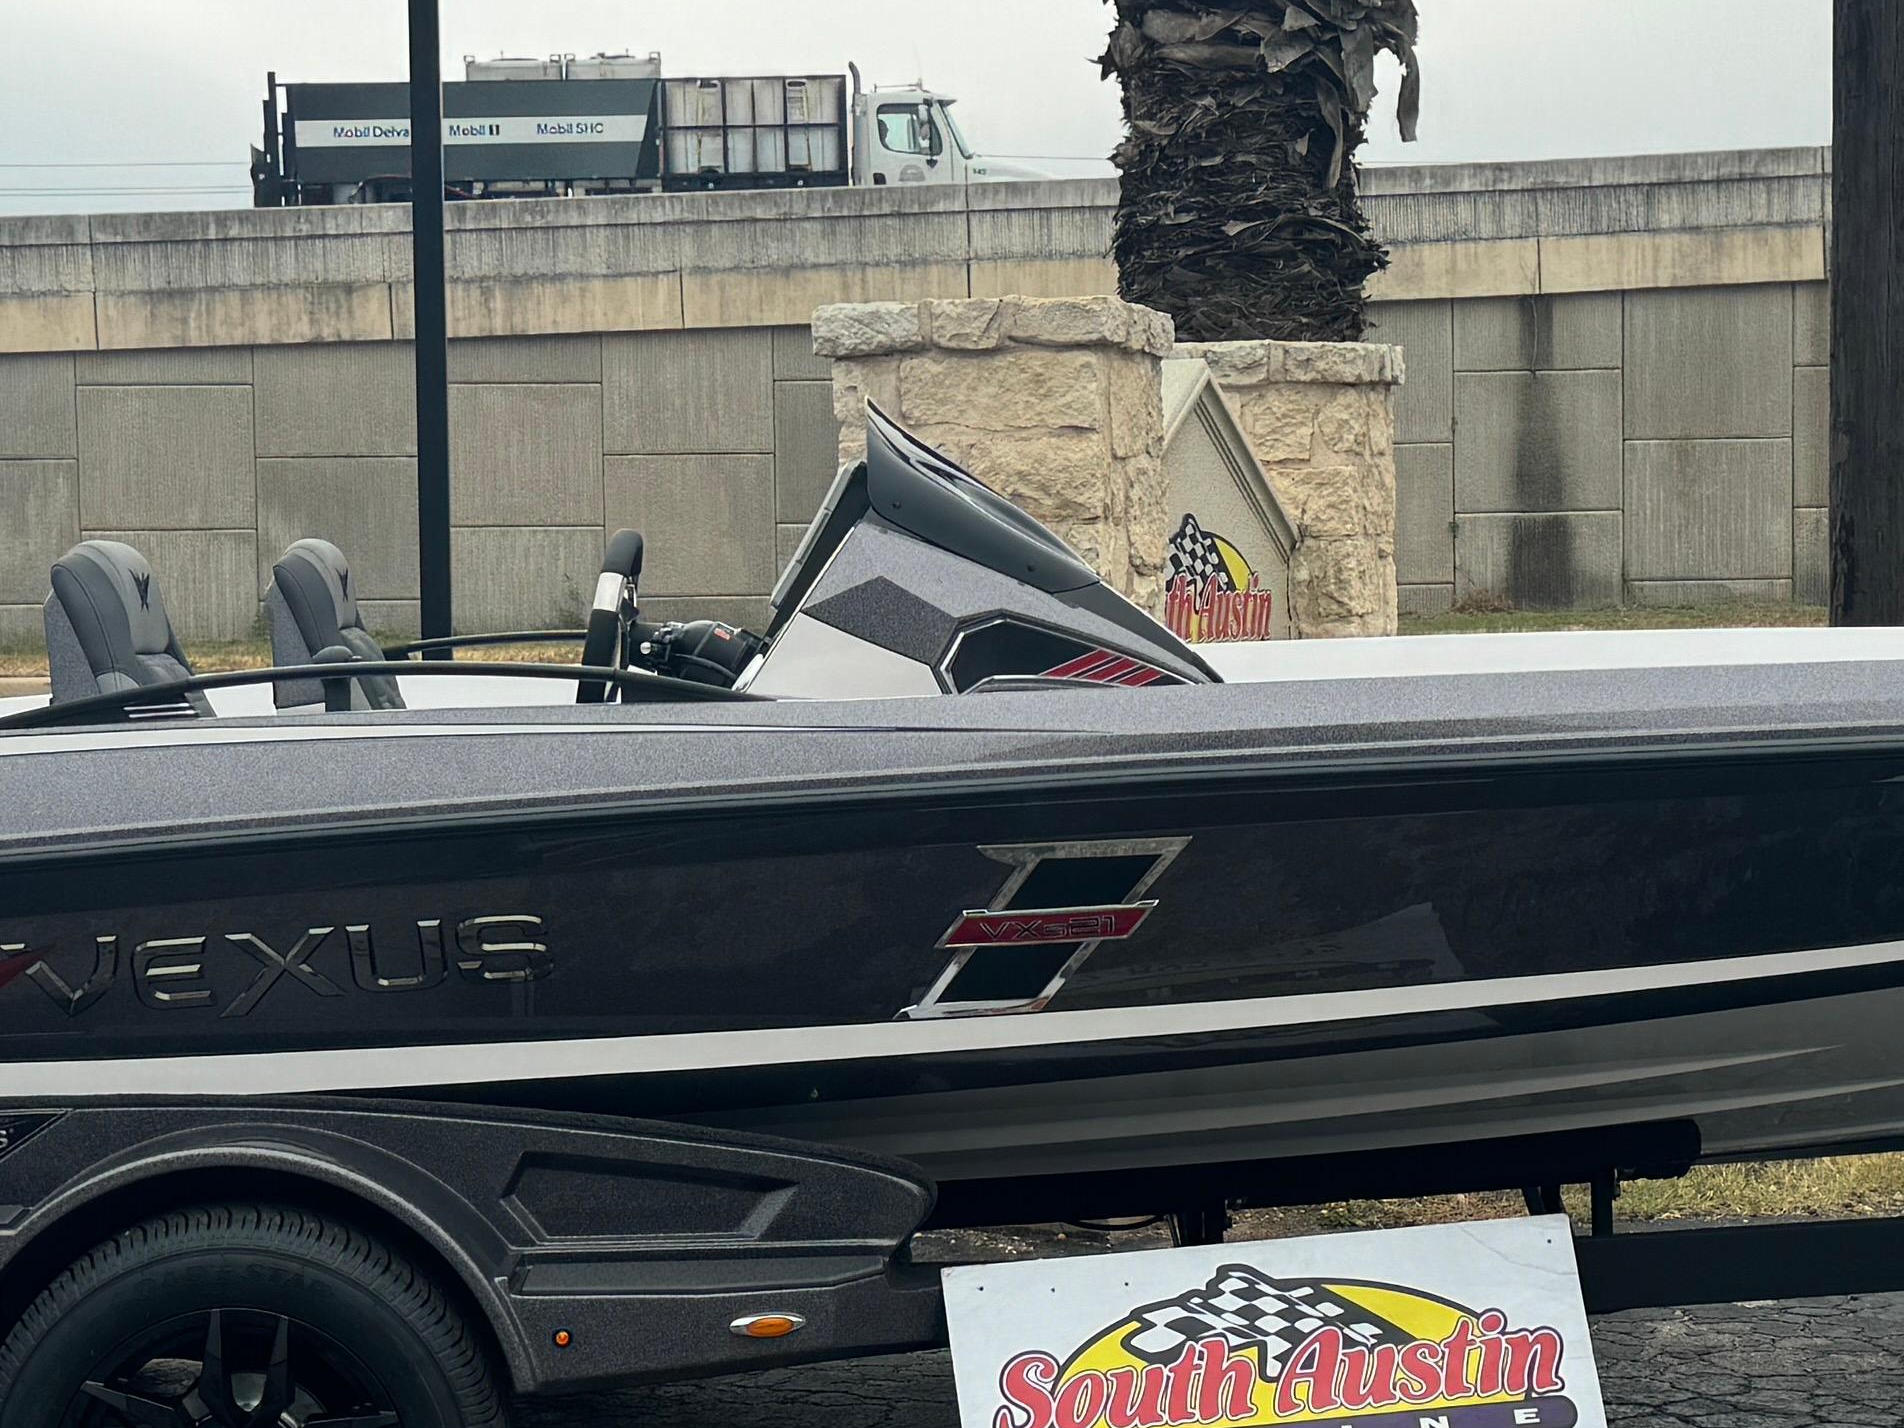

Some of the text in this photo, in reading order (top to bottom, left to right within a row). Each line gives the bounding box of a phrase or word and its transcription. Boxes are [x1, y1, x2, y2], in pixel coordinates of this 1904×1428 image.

[333, 126, 370, 138] Mobil
[449, 124, 486, 136] Mobil
[536, 123, 574, 135] Mobil
[1198, 571, 1272, 644] Austin
[0, 914, 555, 1020] VEXUS
[1274, 1308, 1565, 1416] Austin
